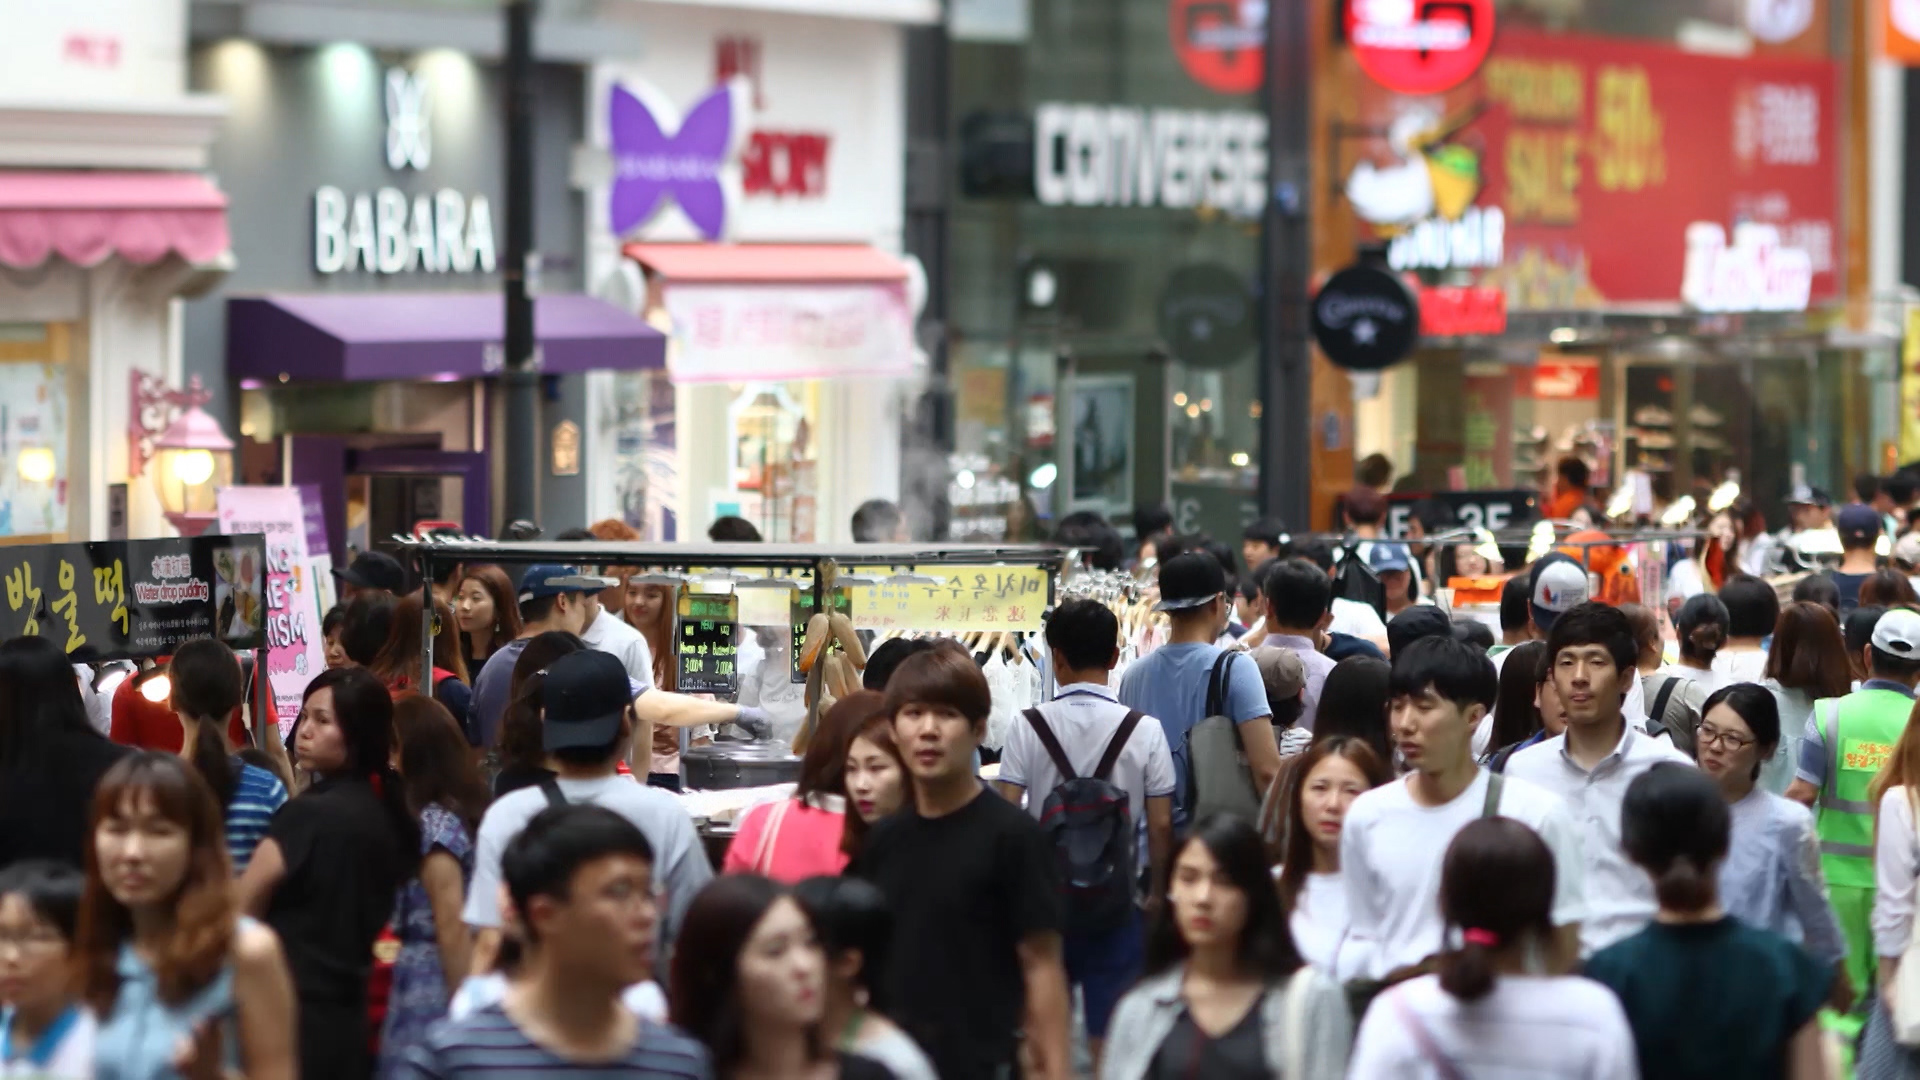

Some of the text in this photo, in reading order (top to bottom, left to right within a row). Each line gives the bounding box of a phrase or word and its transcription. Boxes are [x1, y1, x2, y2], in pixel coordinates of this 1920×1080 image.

[1036, 104, 1268, 214] CONVERSE
[315, 186, 496, 274] BABARA
[135, 578, 209, 604] Water drop pudding
